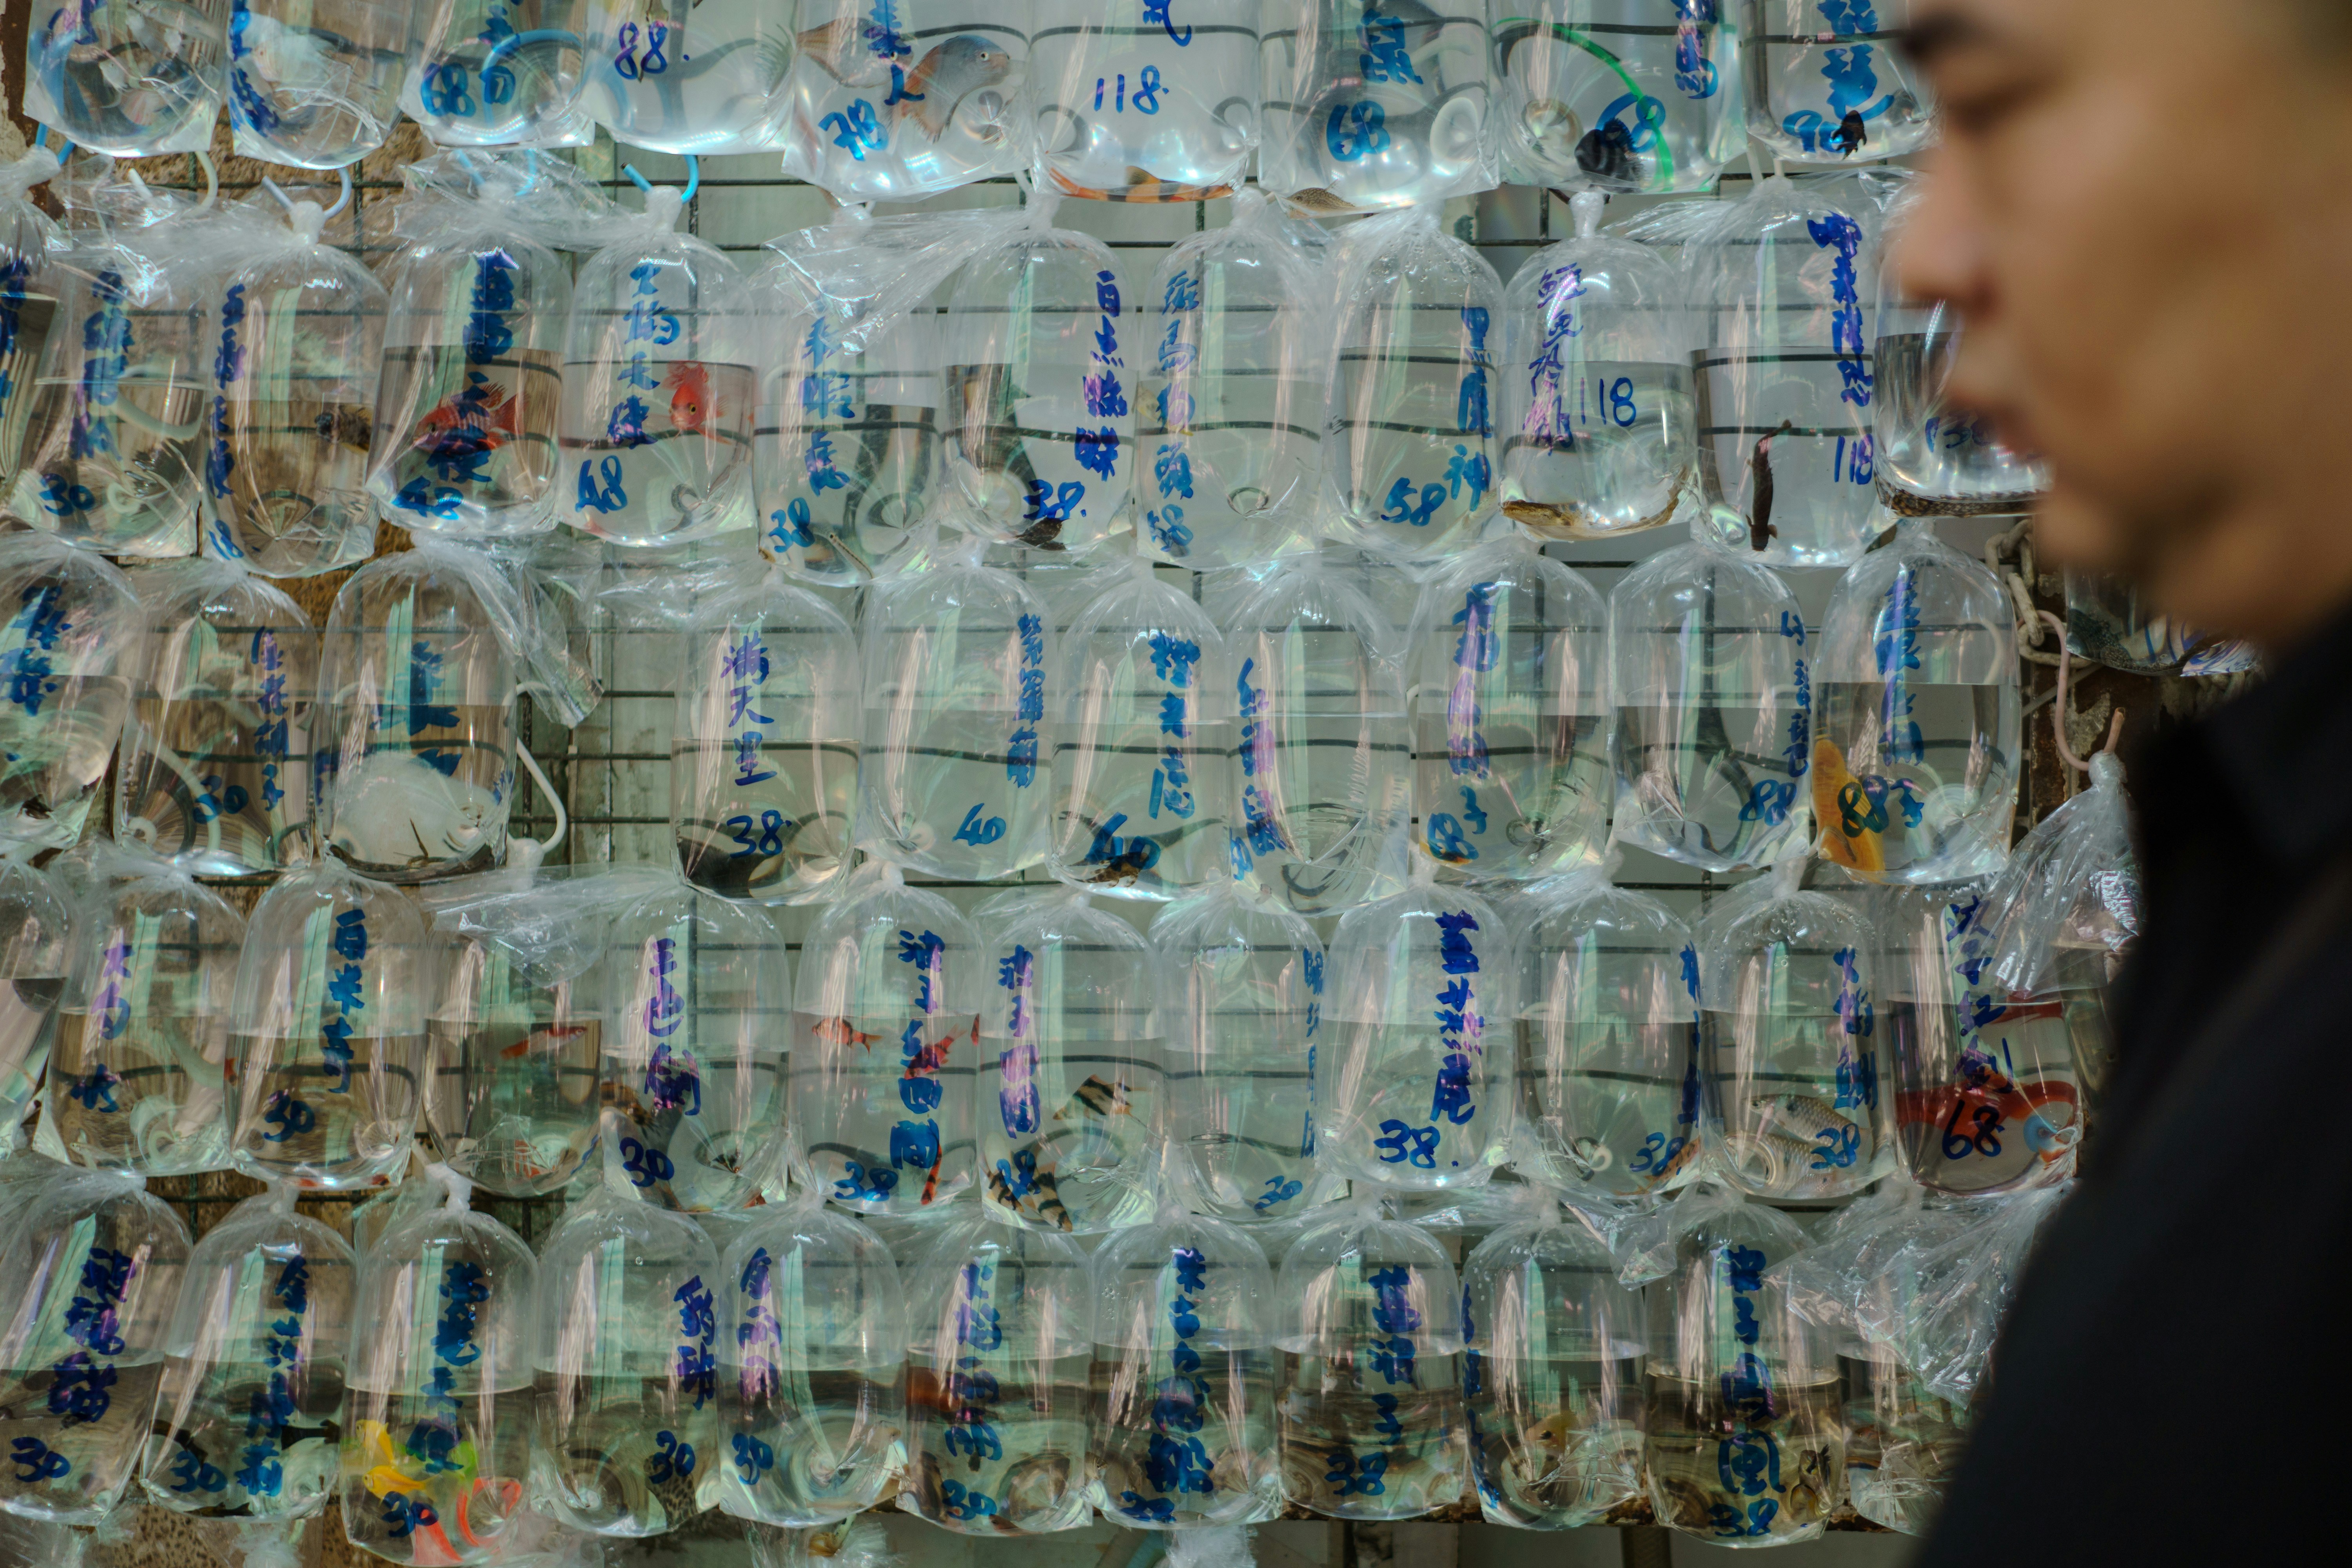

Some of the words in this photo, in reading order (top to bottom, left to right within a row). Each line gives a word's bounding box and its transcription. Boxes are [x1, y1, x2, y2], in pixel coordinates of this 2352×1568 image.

[1326, 100, 1390, 162] 68
[1580, 376, 1637, 426] 118
[575, 455, 628, 514] 48
[1834, 433, 1874, 485] 118
[38, 473, 95, 517] 30
[1380, 477, 1447, 527] 58
[768, 497, 815, 553] 38
[951, 802, 1007, 847] 40
[1738, 779, 1797, 827] 88
[1837, 775, 1889, 838] 88
[619, 1136, 676, 1188] 30
[10, 1436, 71, 1484] 30
[648, 1430, 696, 1485] 30
[731, 1432, 774, 1486] 30
[1324, 1451, 1389, 1497] 38
